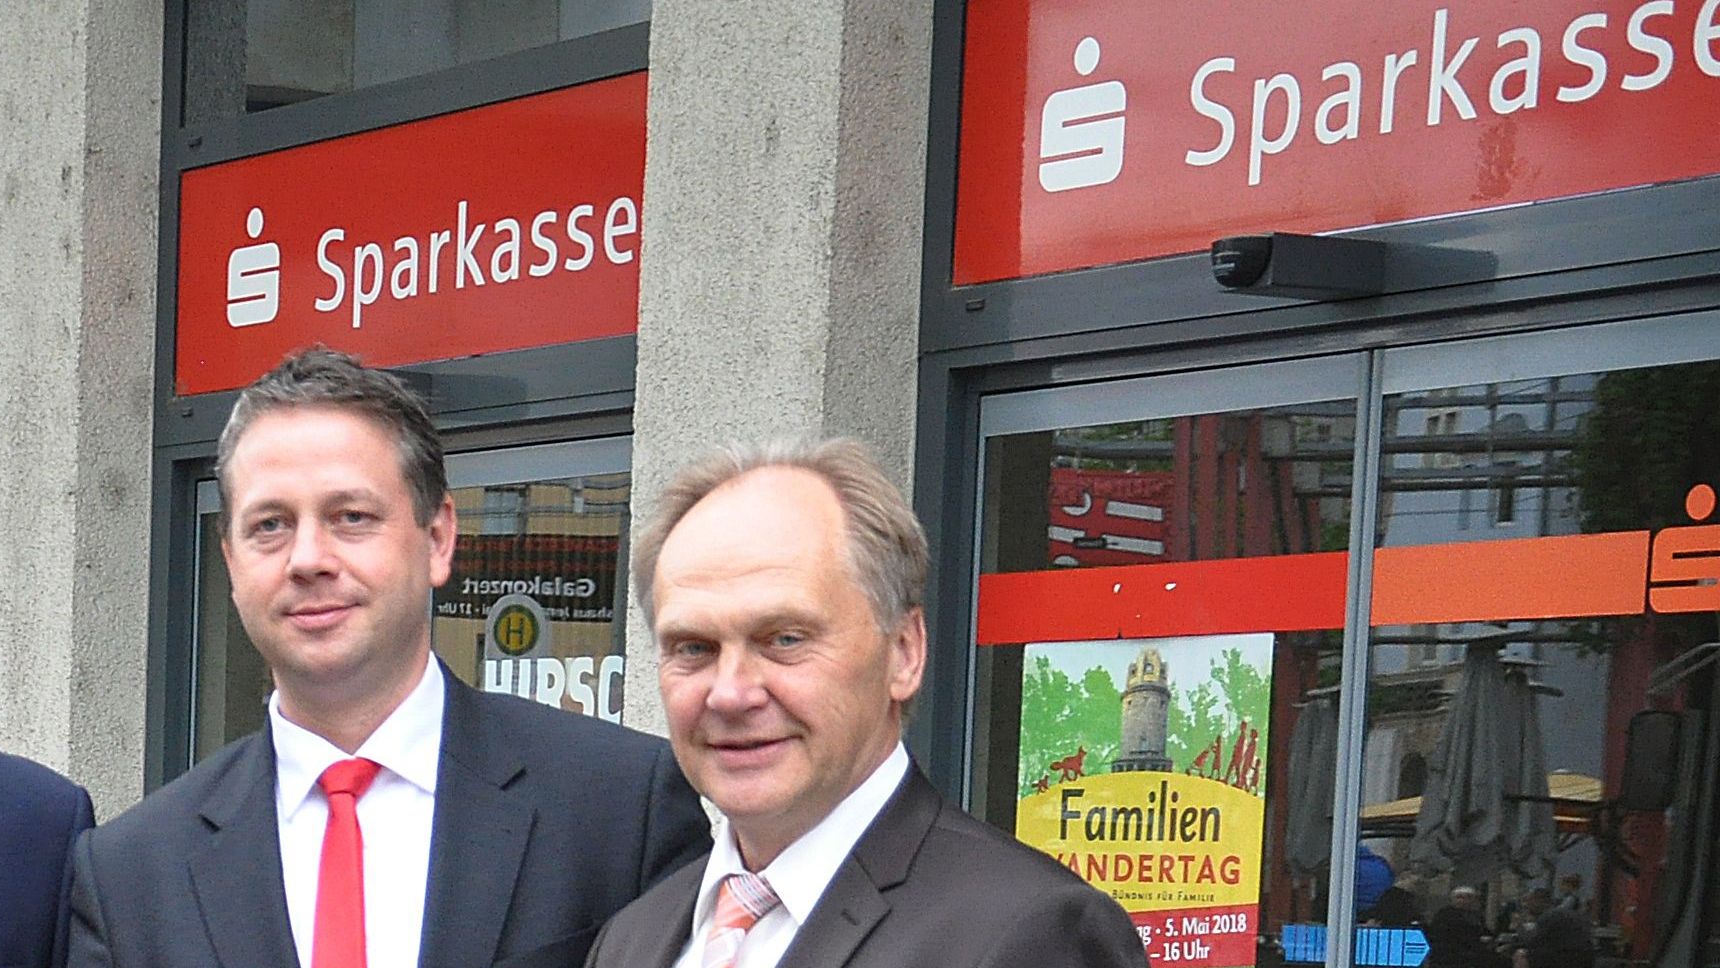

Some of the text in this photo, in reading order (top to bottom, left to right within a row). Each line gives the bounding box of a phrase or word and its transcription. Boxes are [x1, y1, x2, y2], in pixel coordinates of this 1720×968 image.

[314, 196, 638, 329] Sparkasse
[506, 616, 525, 647] H
[1059, 780, 1221, 843] Familien
[1055, 853, 1241, 885] ANDERTAG
[1165, 918, 1178, 937] 5.
[1182, 916, 1210, 936] Mai
[1211, 913, 1247, 934] 2018
[1163, 942, 1180, 961] 16
[1183, 938, 1210, 960] Uhr
